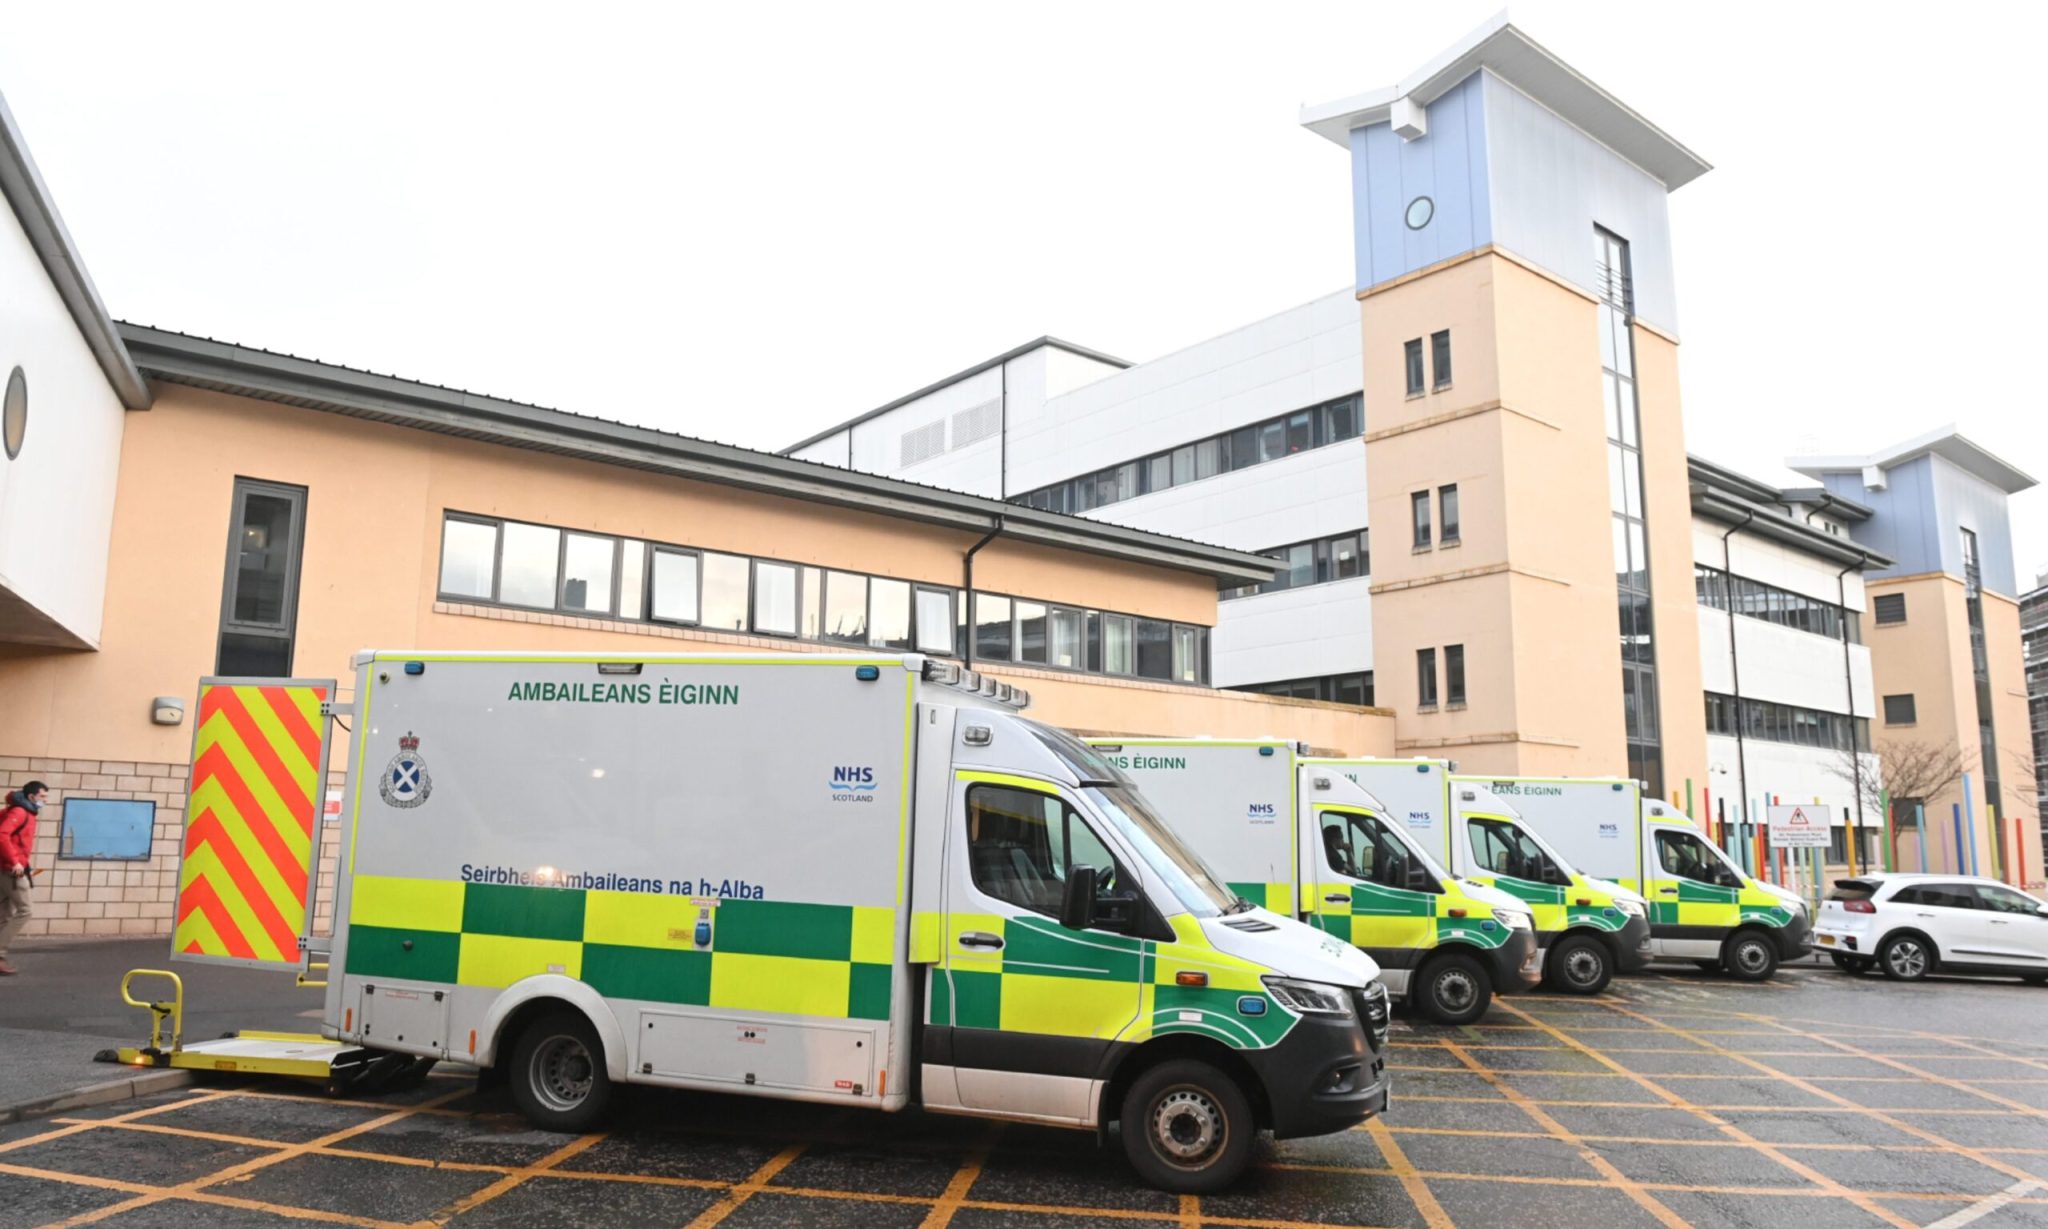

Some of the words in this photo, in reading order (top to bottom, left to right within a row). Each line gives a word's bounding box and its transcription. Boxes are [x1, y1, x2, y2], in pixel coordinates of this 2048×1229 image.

[508, 682, 652, 704] AMBAILEANS
[658, 677, 740, 705] ÈIGINN
[834, 766, 873, 782] NHS
[832, 793, 874, 803] SCOTLAND
[1249, 803, 1274, 814] NHS
[1409, 811, 1430, 820] NHS
[552, 868, 663, 894] Ambaileans
[669, 879, 693, 896] na
[699, 877, 764, 900] h-Alba
